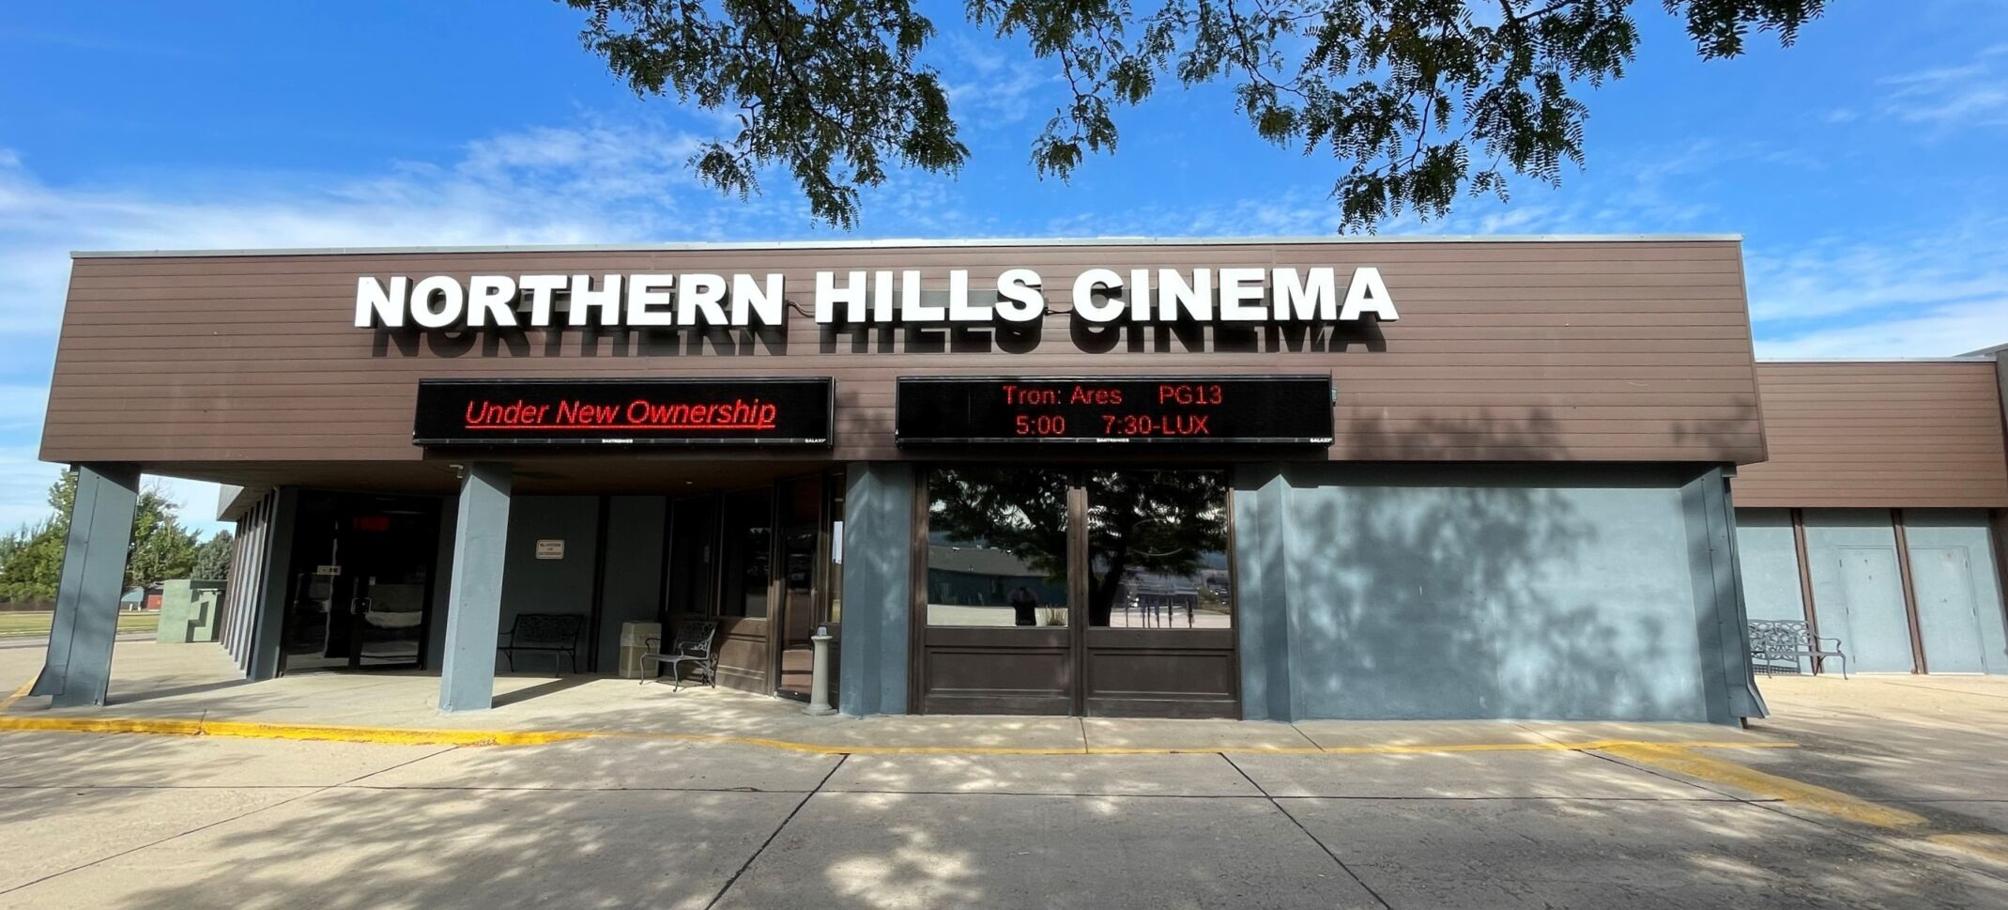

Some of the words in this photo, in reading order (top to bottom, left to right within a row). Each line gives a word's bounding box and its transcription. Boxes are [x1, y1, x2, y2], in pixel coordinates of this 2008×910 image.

[355, 274, 785, 328] NORTHERN
[815, 269, 1045, 323] HILLS
[1072, 267, 1400, 322] CINEMA
[1002, 385, 1062, 405] Tron:
[1070, 385, 1123, 405] Ares
[1159, 385, 1223, 405] PG13
[466, 399, 547, 425] Under
[556, 400, 617, 425] New
[626, 399, 777, 430] Ownership
[1015, 415, 1065, 435] 5:00
[1102, 415, 1210, 435] 7:30-LUX
